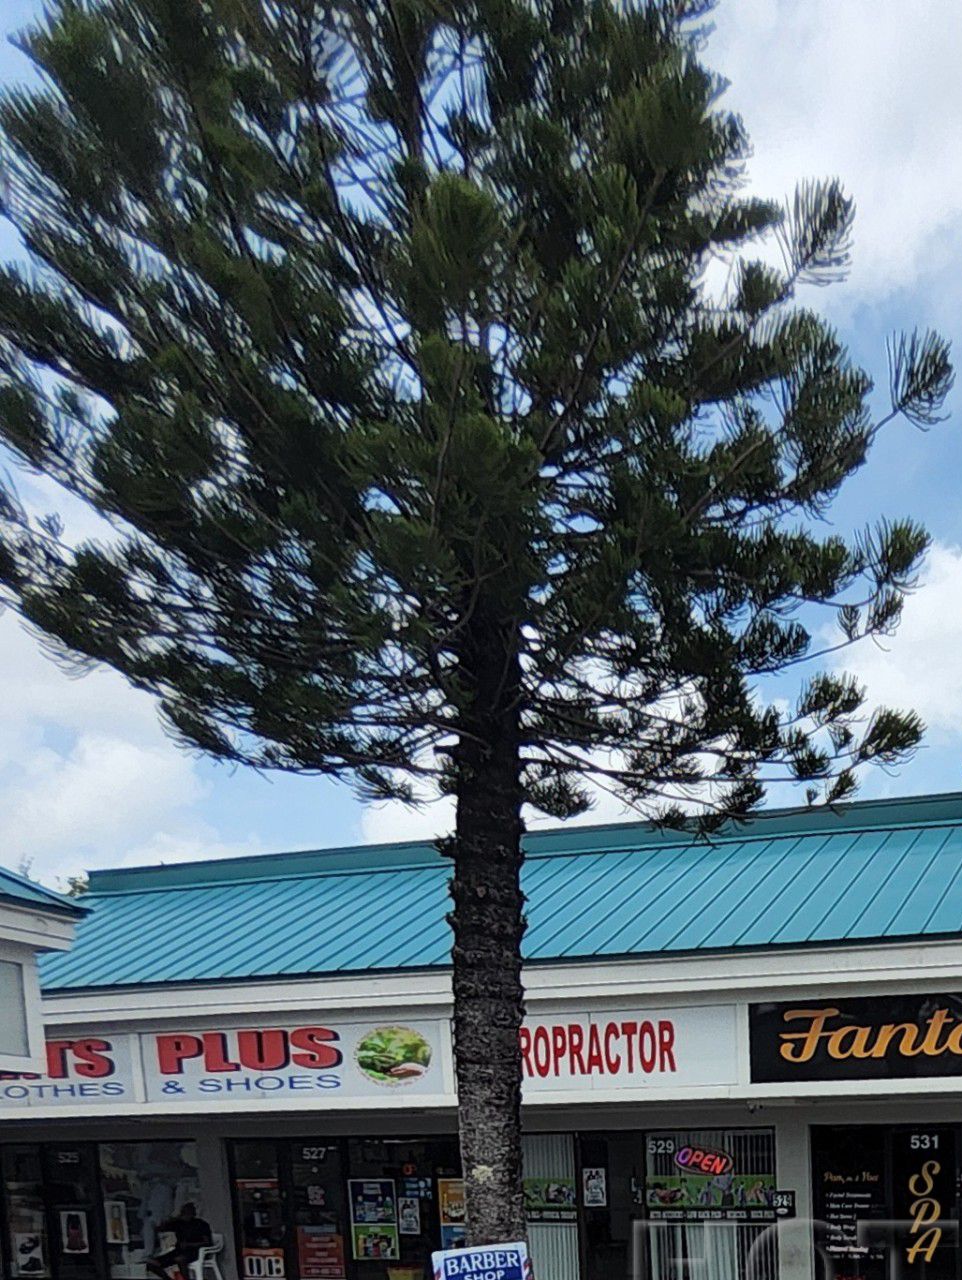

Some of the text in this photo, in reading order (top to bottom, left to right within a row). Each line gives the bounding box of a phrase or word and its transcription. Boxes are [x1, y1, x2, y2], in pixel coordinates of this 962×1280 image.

[156, 1026, 342, 1075] PLUS
[161, 1074, 341, 1094] & SHOES
[649, 1140, 675, 1154] 529
[910, 1134, 940, 1149] 531
[302, 1147, 326, 1160] 527
[676, 1148, 727, 1174] OPEN
[446, 1251, 519, 1276] BARBER
